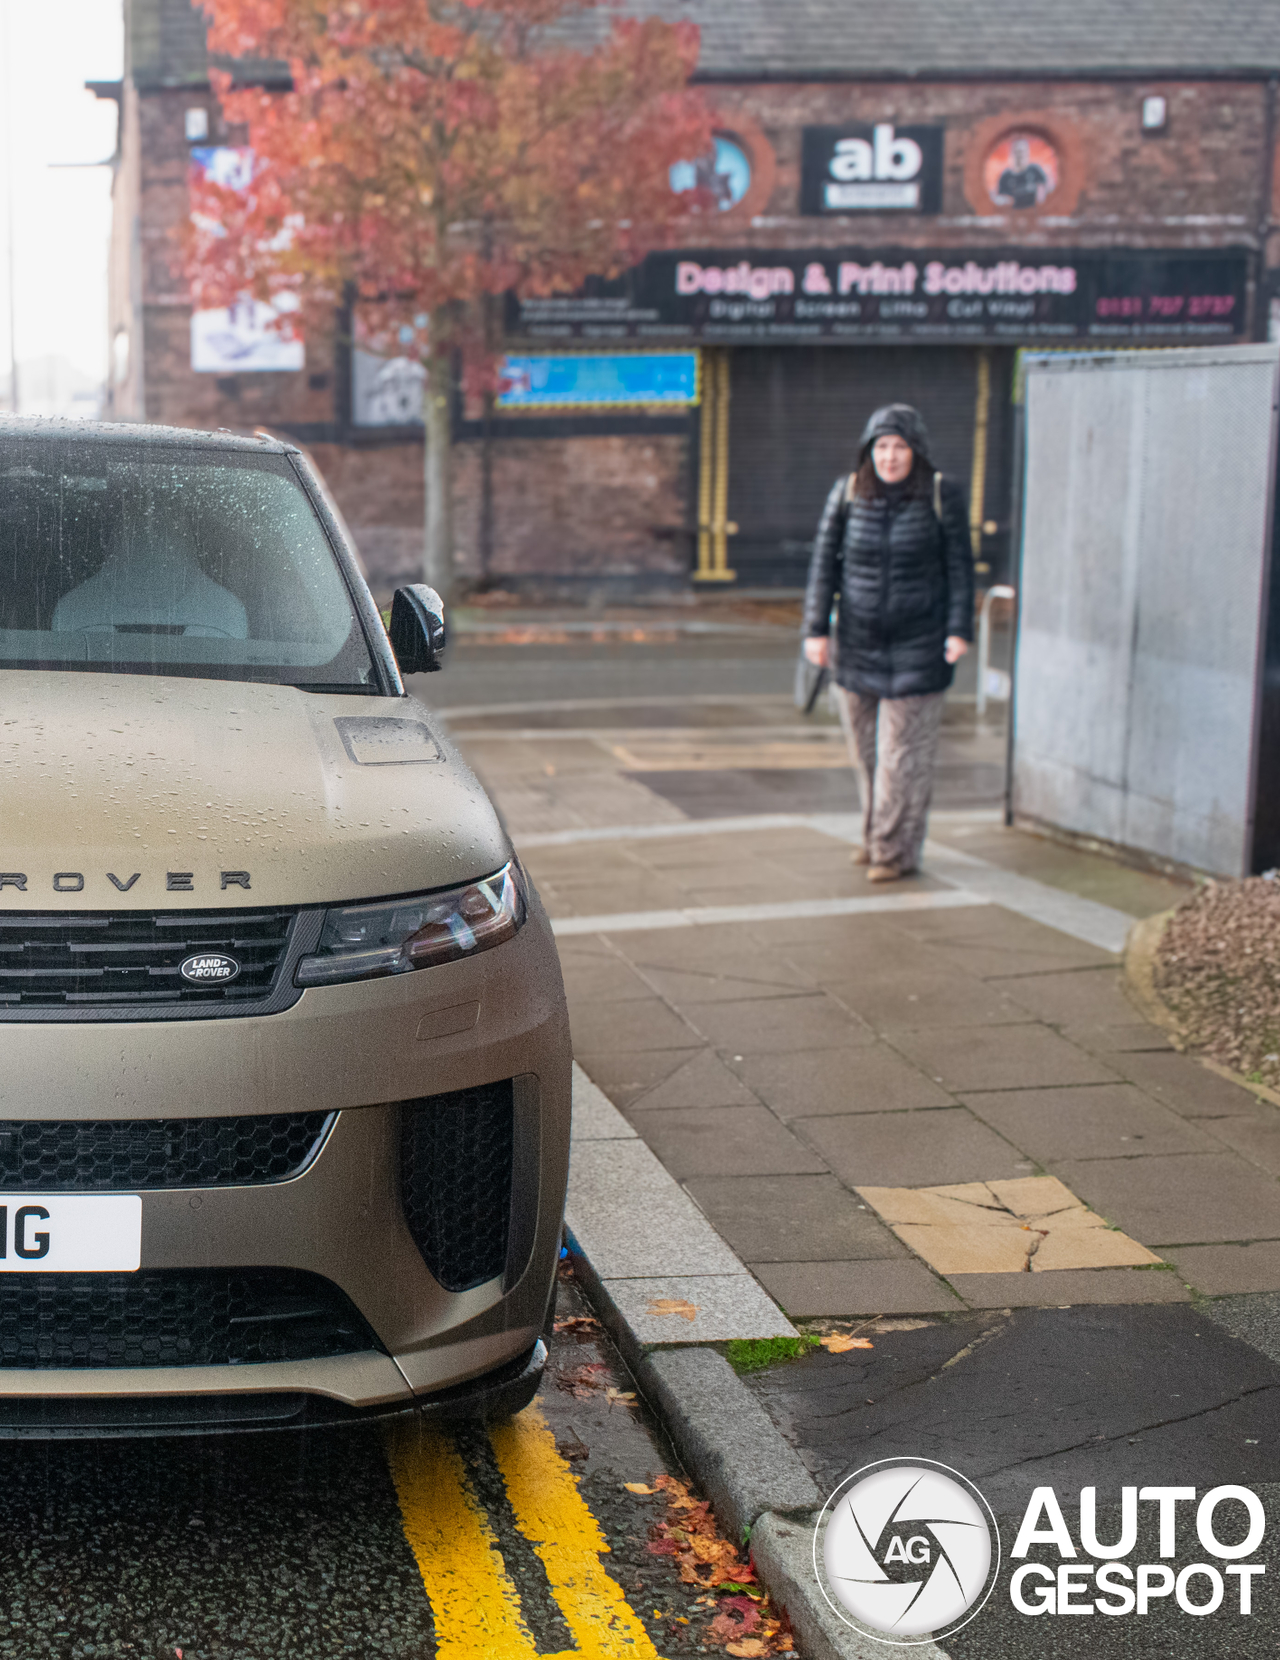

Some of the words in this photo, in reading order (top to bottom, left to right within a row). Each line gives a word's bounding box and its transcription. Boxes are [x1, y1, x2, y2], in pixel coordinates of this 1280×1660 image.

[829, 123, 921, 181] ab
[675, 261, 794, 299] Design
[802, 262, 831, 296] &
[838, 261, 917, 296] Print
[923, 261, 1077, 296] Solutions
[709, 299, 775, 320] Digital
[795, 299, 861, 318] Screen
[880, 299, 928, 318] Litho
[947, 299, 983, 318] Cut
[987, 299, 1035, 319] Vinyl
[192, 959, 221, 969] LAND
[195, 967, 231, 977] ROVER
